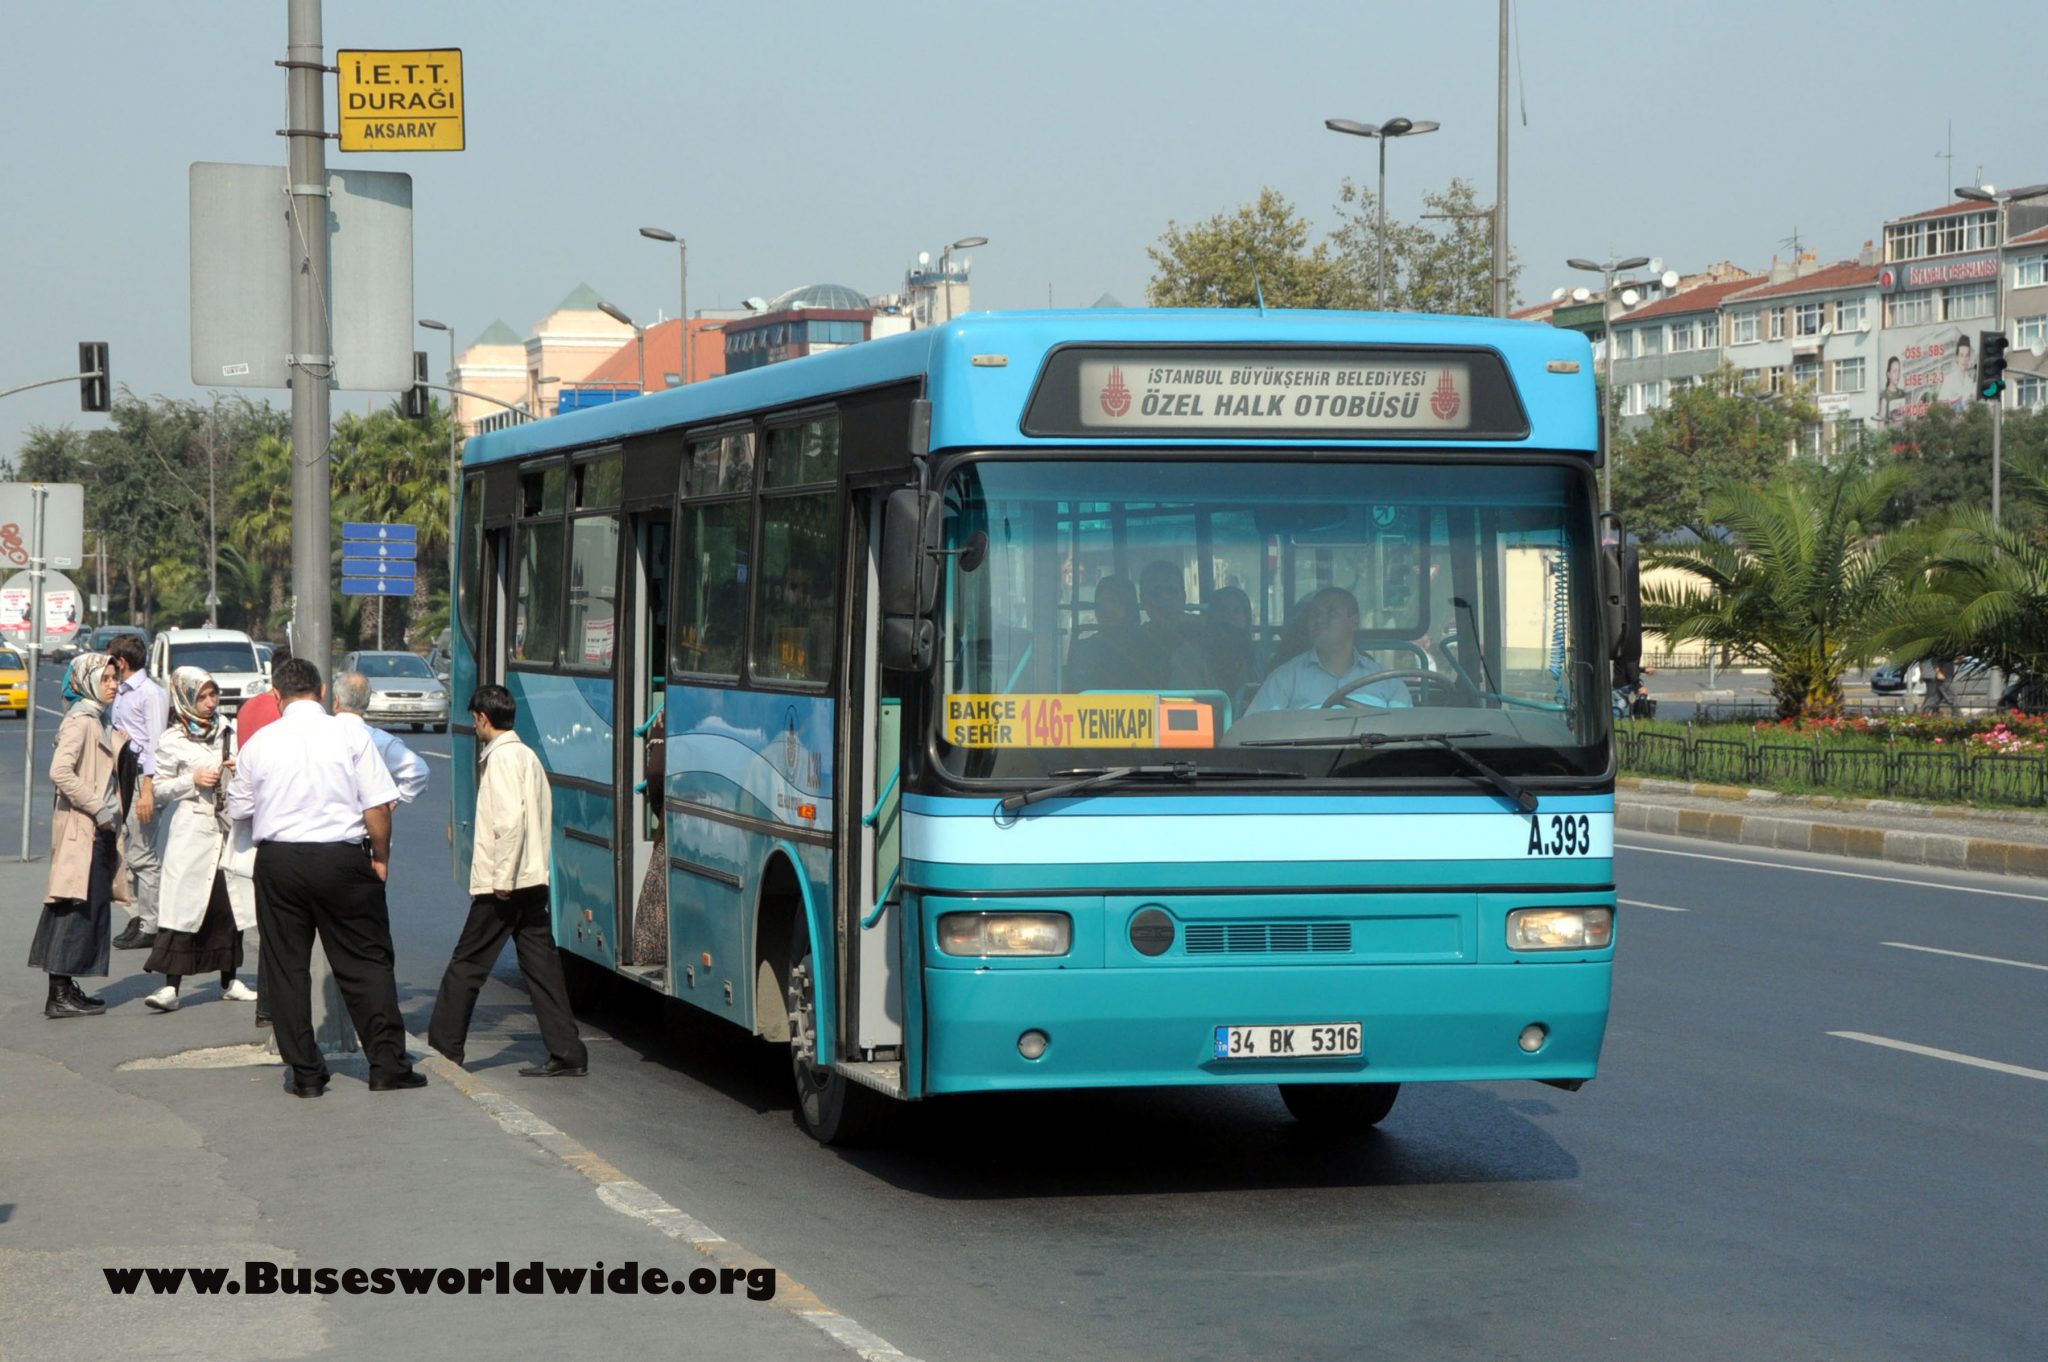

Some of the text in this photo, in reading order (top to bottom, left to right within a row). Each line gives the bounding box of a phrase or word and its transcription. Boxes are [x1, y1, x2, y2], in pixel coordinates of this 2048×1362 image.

[355, 61, 449, 86] İ.E.T.T.
[349, 88, 455, 111] DURAĞI
[364, 122, 437, 139] AKSARAY
[1928, 344, 1945, 356] SBS
[1141, 389, 1420, 419] ÖZEL HALK OTOBÜSÜ
[950, 700, 1016, 722] BAHÇE
[1528, 815, 1590, 855] A.393
[1231, 1027, 1359, 1053] 34 BK 5316
